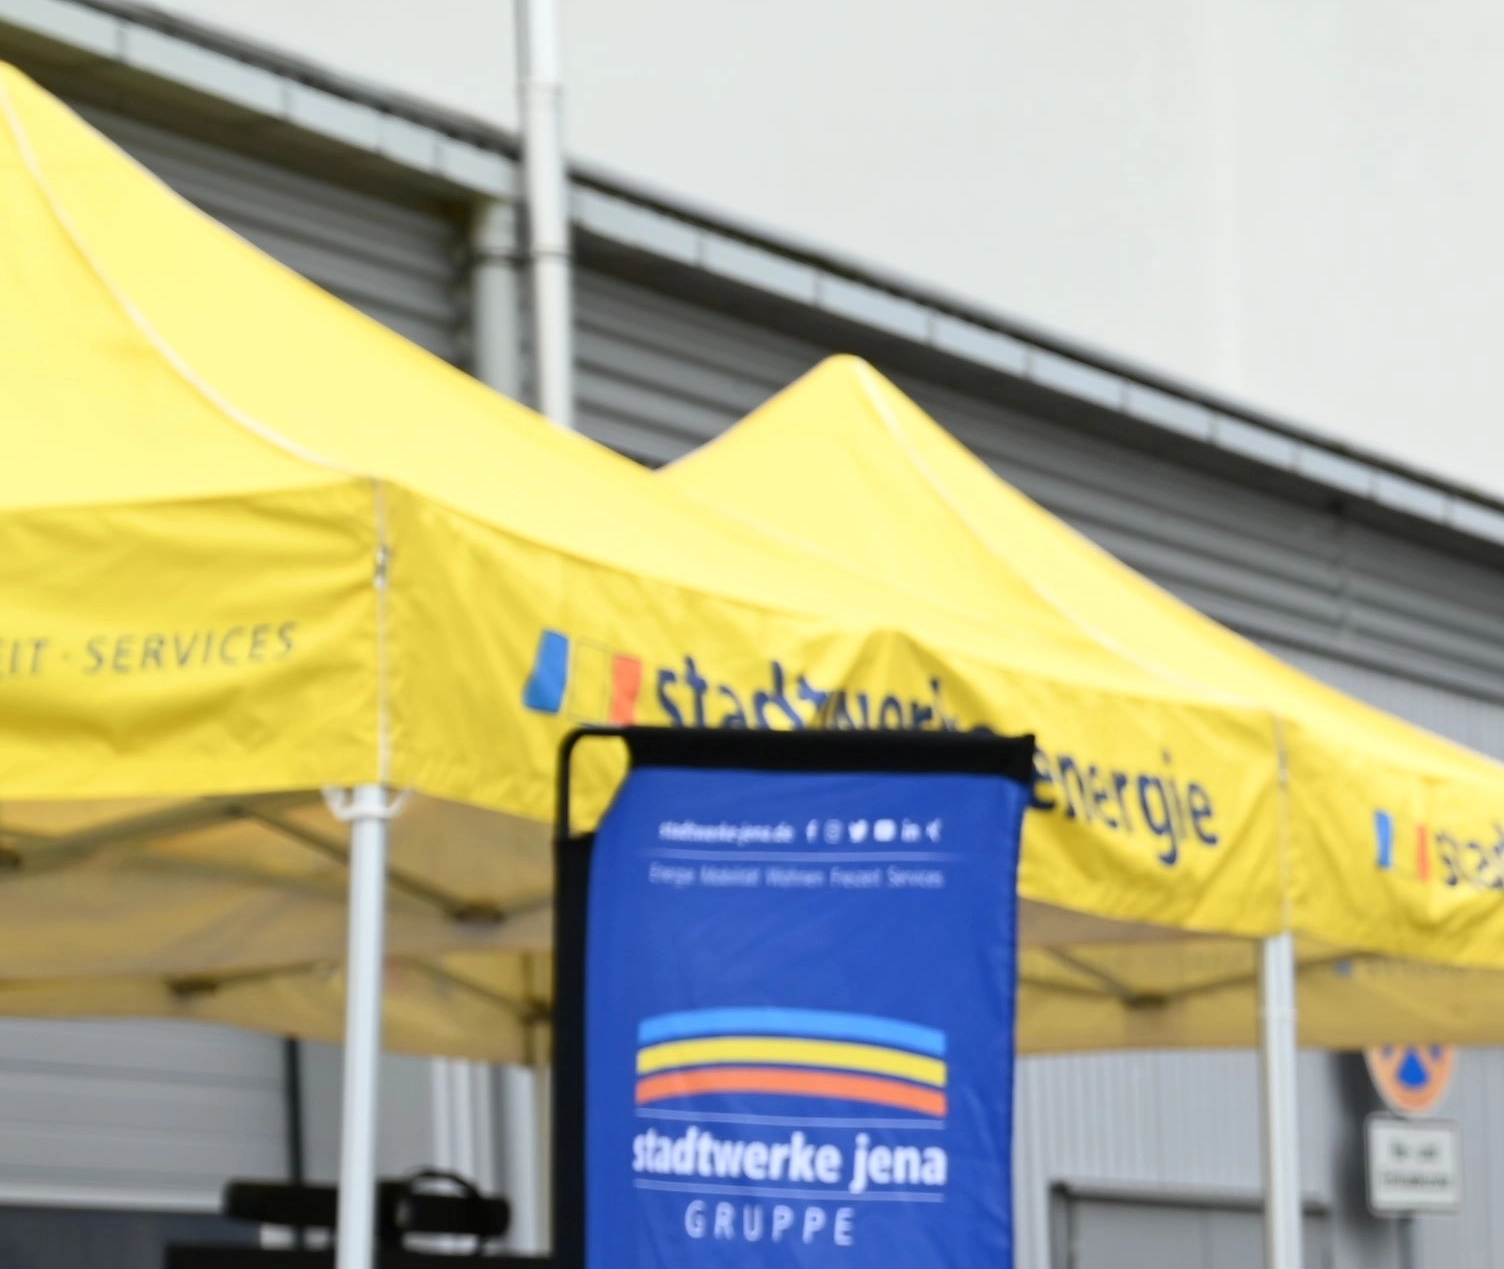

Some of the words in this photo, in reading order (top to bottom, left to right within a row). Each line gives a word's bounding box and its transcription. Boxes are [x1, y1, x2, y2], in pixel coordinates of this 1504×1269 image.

[0, 636, 53, 676] IT
[81, 620, 298, 675] SERVICES
[632, 1125, 842, 1183] stadtwerke
[849, 1132, 948, 1195] jena
[683, 1199, 855, 1247] GRUPPE
